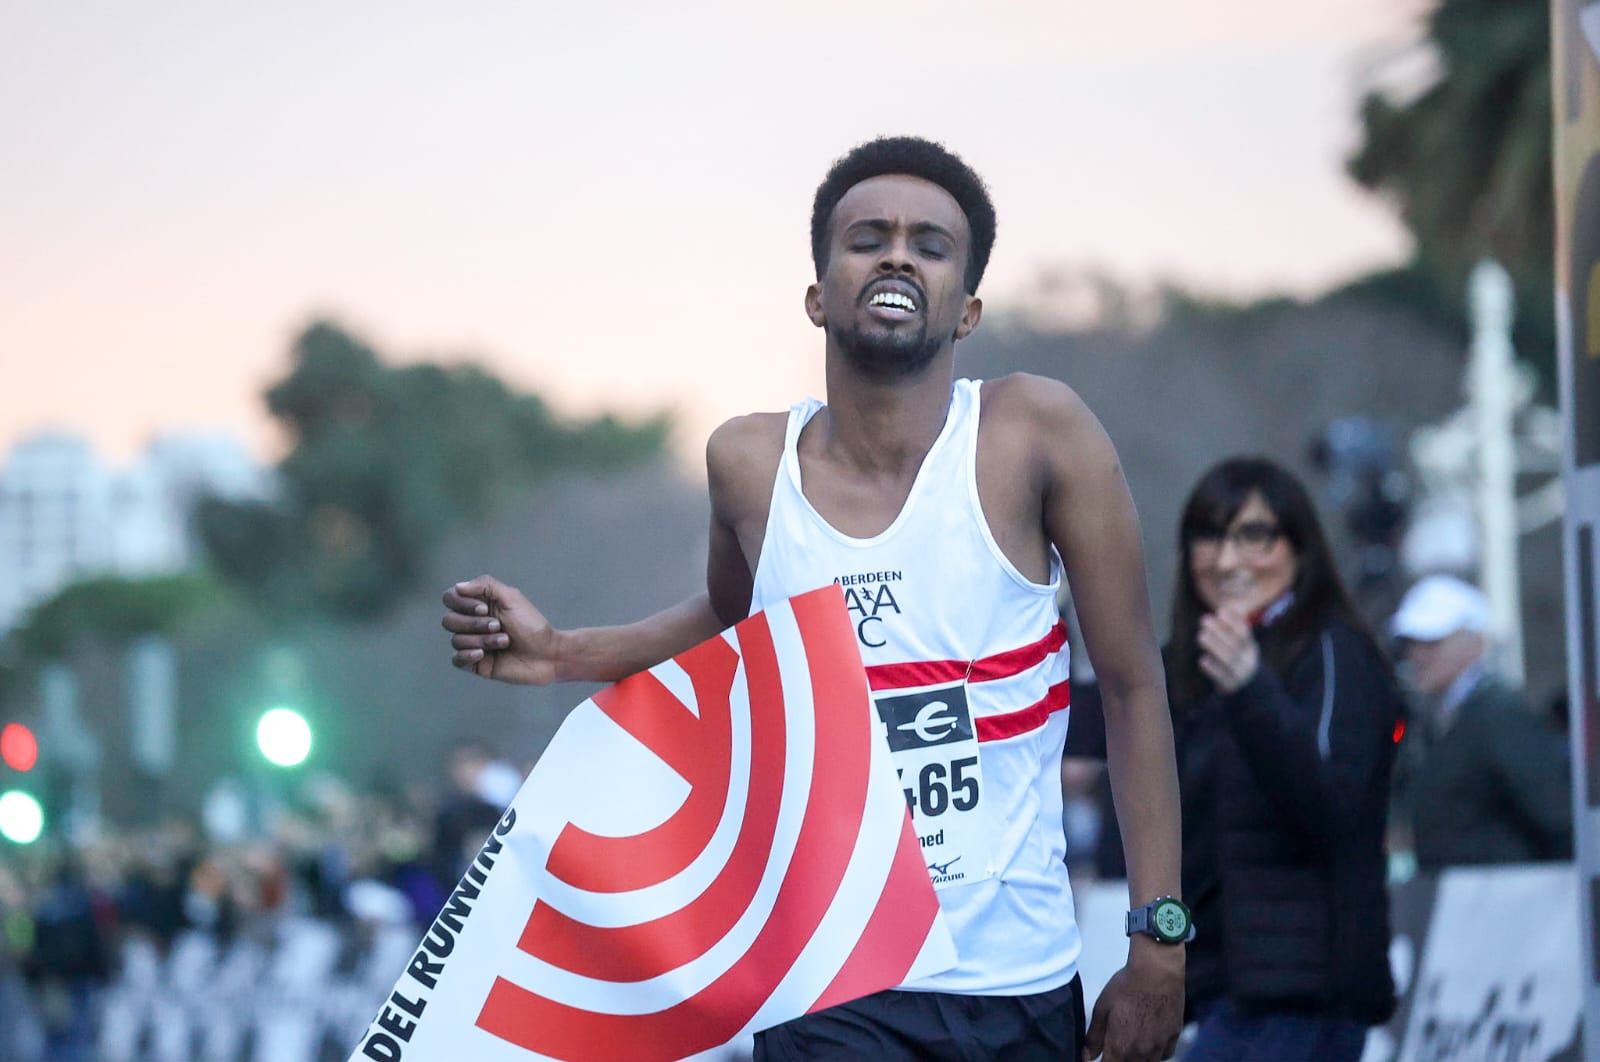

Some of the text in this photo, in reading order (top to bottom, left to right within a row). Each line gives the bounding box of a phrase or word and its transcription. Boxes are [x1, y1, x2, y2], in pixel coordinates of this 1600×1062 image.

[833, 570, 902, 587] ABERDEEN
[857, 616, 887, 648] C
[362, 807, 517, 1062] DEL RUNNING
